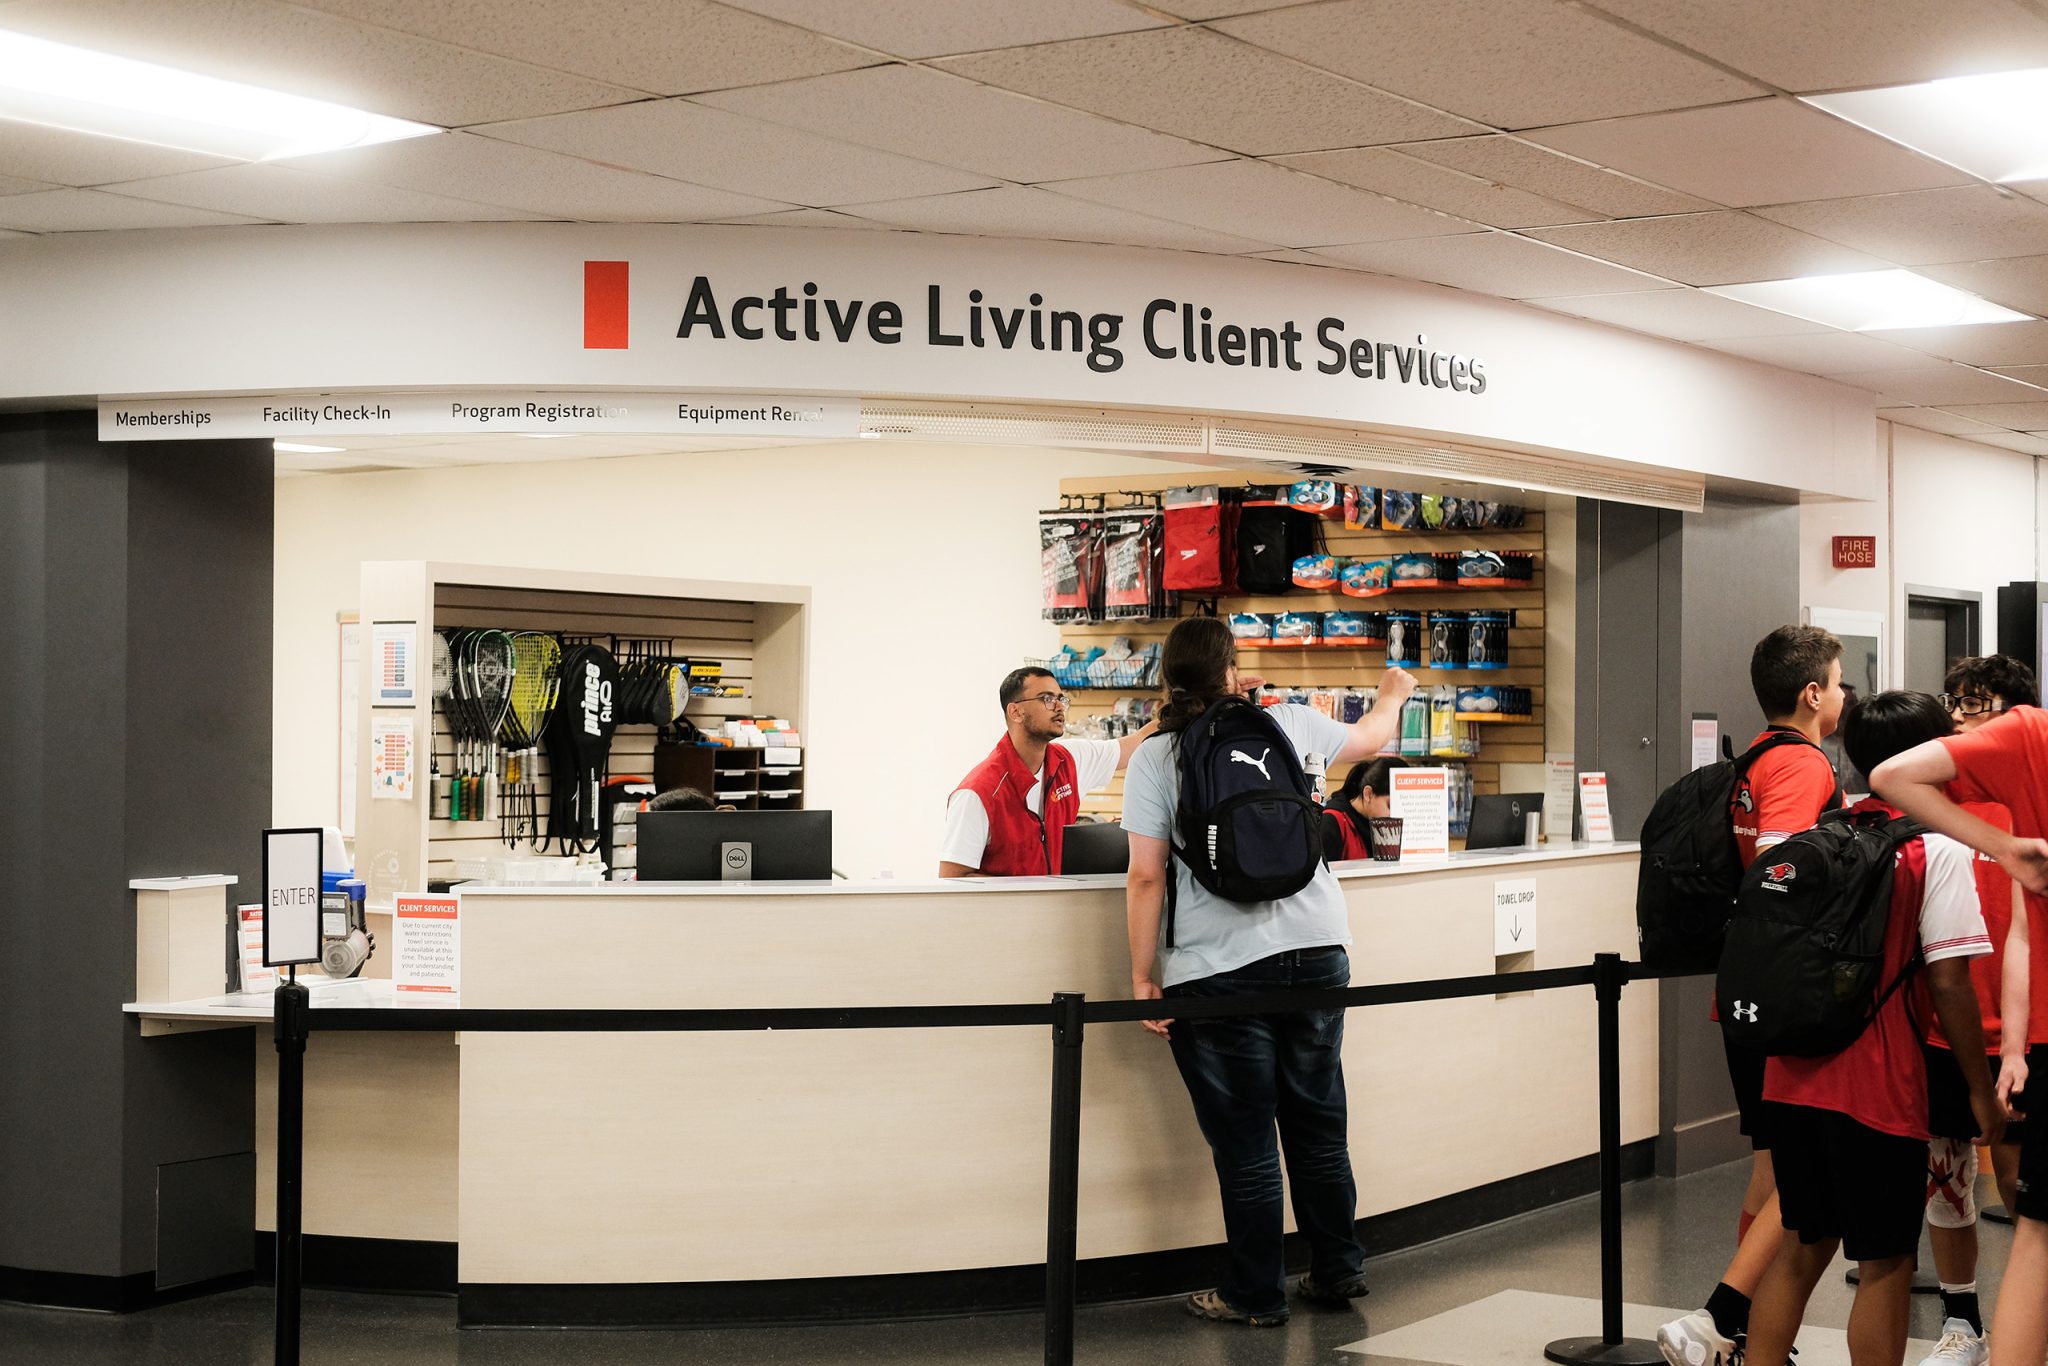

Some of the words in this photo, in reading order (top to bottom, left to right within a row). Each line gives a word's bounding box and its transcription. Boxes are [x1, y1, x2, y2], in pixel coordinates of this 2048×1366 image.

[677, 276, 902, 344] Active
[928, 285, 1124, 373] Living
[1142, 299, 1302, 371] Client
[1317, 317, 1487, 394] Services
[116, 410, 211, 427] Memberships
[263, 407, 319, 425] Facility
[323, 405, 391, 421] Check-In
[452, 403, 521, 421] Program
[526, 403, 628, 421] Registration
[678, 404, 767, 423] Equipment
[1842, 540, 1869, 551] FIRE
[1839, 552, 1872, 563] HOSE
[581, 662, 600, 736] prince
[1418, 777, 1443, 785] SERVICES
[272, 887, 315, 906] ENTER
[1498, 893, 1517, 905] TOWEL
[1519, 891, 1534, 903] DROP
[400, 904, 422, 912] CLIENT
[424, 905, 455, 913] SERVICES
[416, 962, 454, 971] understanding
